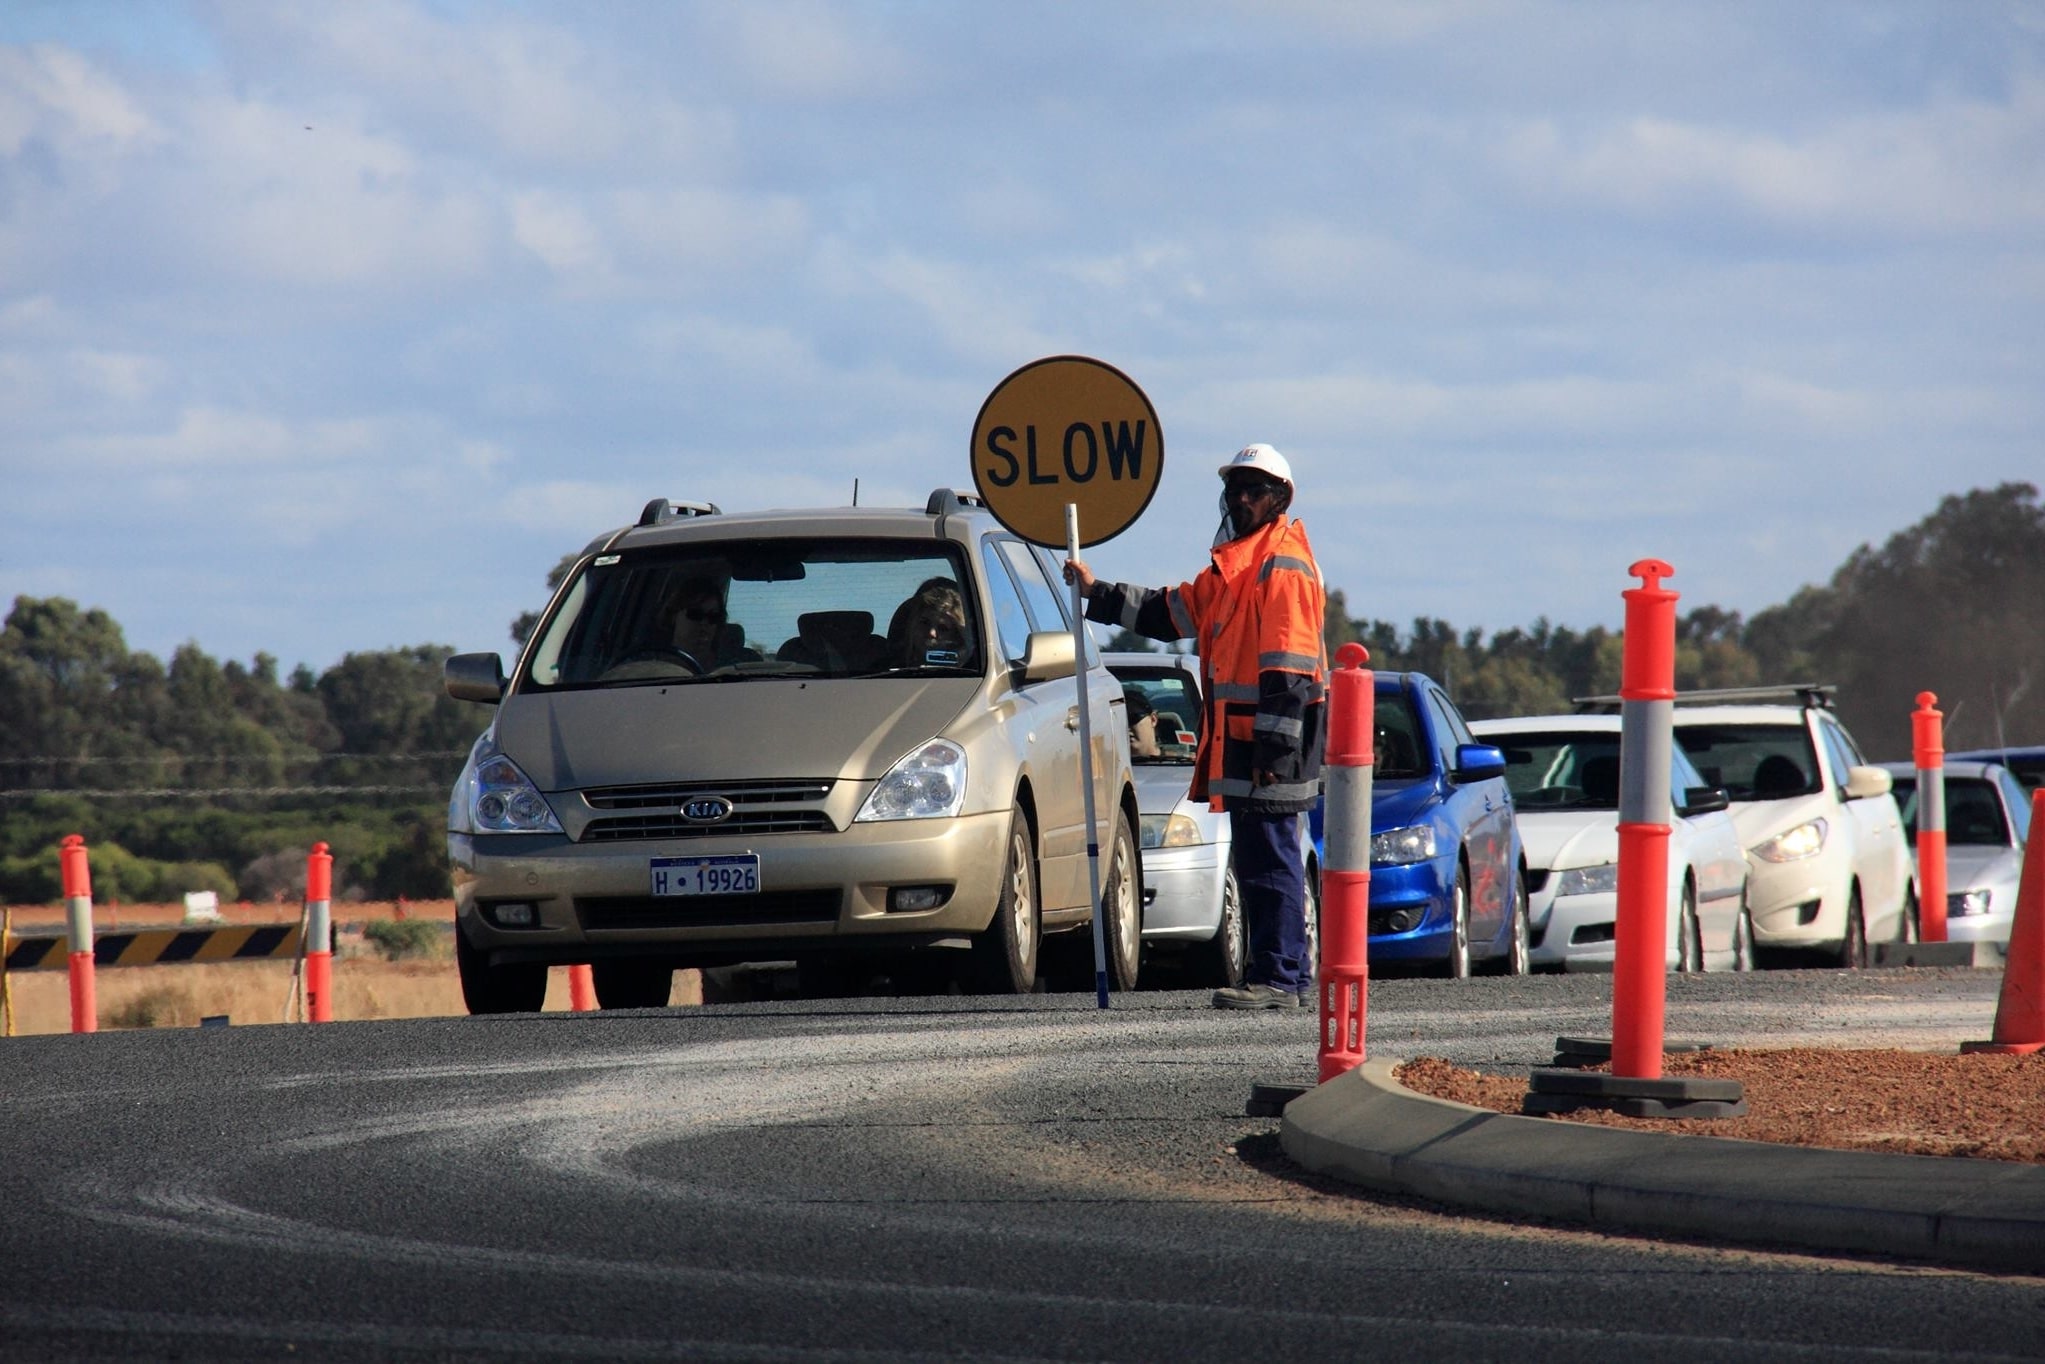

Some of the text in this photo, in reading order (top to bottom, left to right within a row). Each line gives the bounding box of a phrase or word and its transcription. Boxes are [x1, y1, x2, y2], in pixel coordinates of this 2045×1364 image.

[986, 419, 1146, 488] SLOW
[689, 802, 723, 817] KIA
[696, 868, 756, 893] 19926
